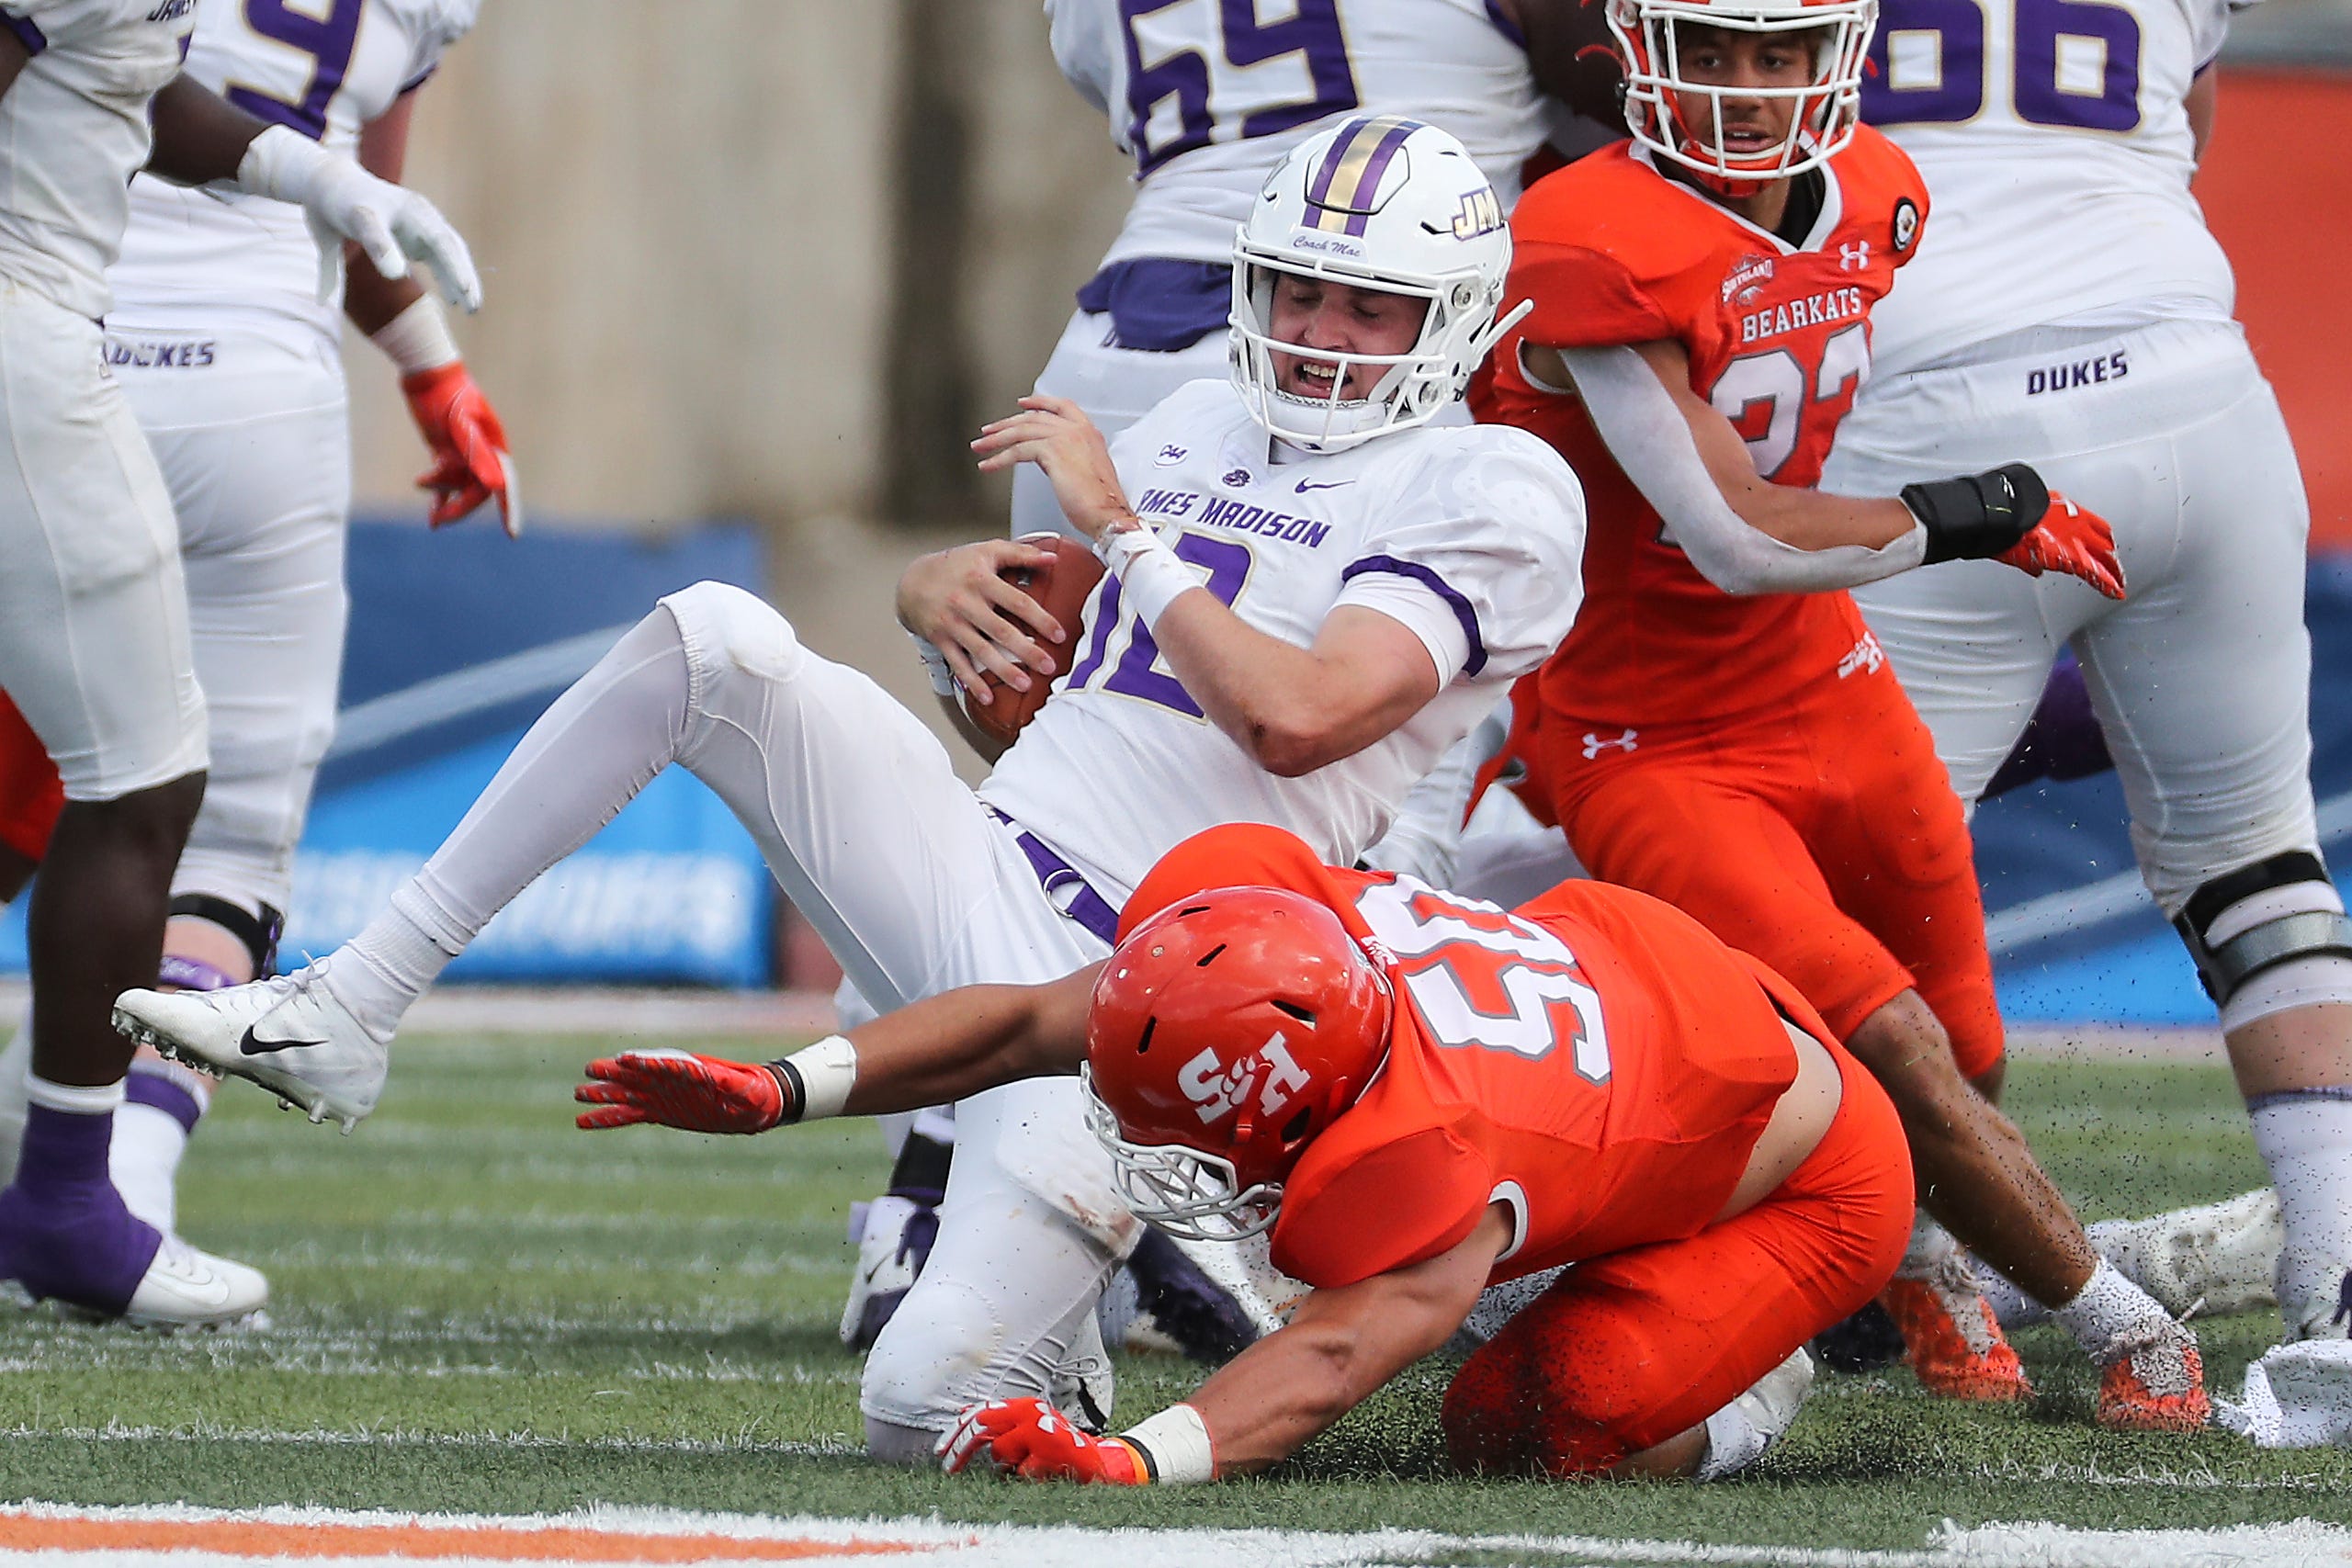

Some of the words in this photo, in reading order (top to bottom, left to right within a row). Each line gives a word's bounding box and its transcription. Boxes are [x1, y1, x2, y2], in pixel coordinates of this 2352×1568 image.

[1293, 235, 1328, 250] Coach
[1331, 242, 1361, 257] Mac
[1742, 287, 1862, 344] BEARKATS
[2028, 348, 2128, 395] DUKES
[1136, 488, 1200, 517] AMES
[1196, 496, 1332, 549] MADISON
